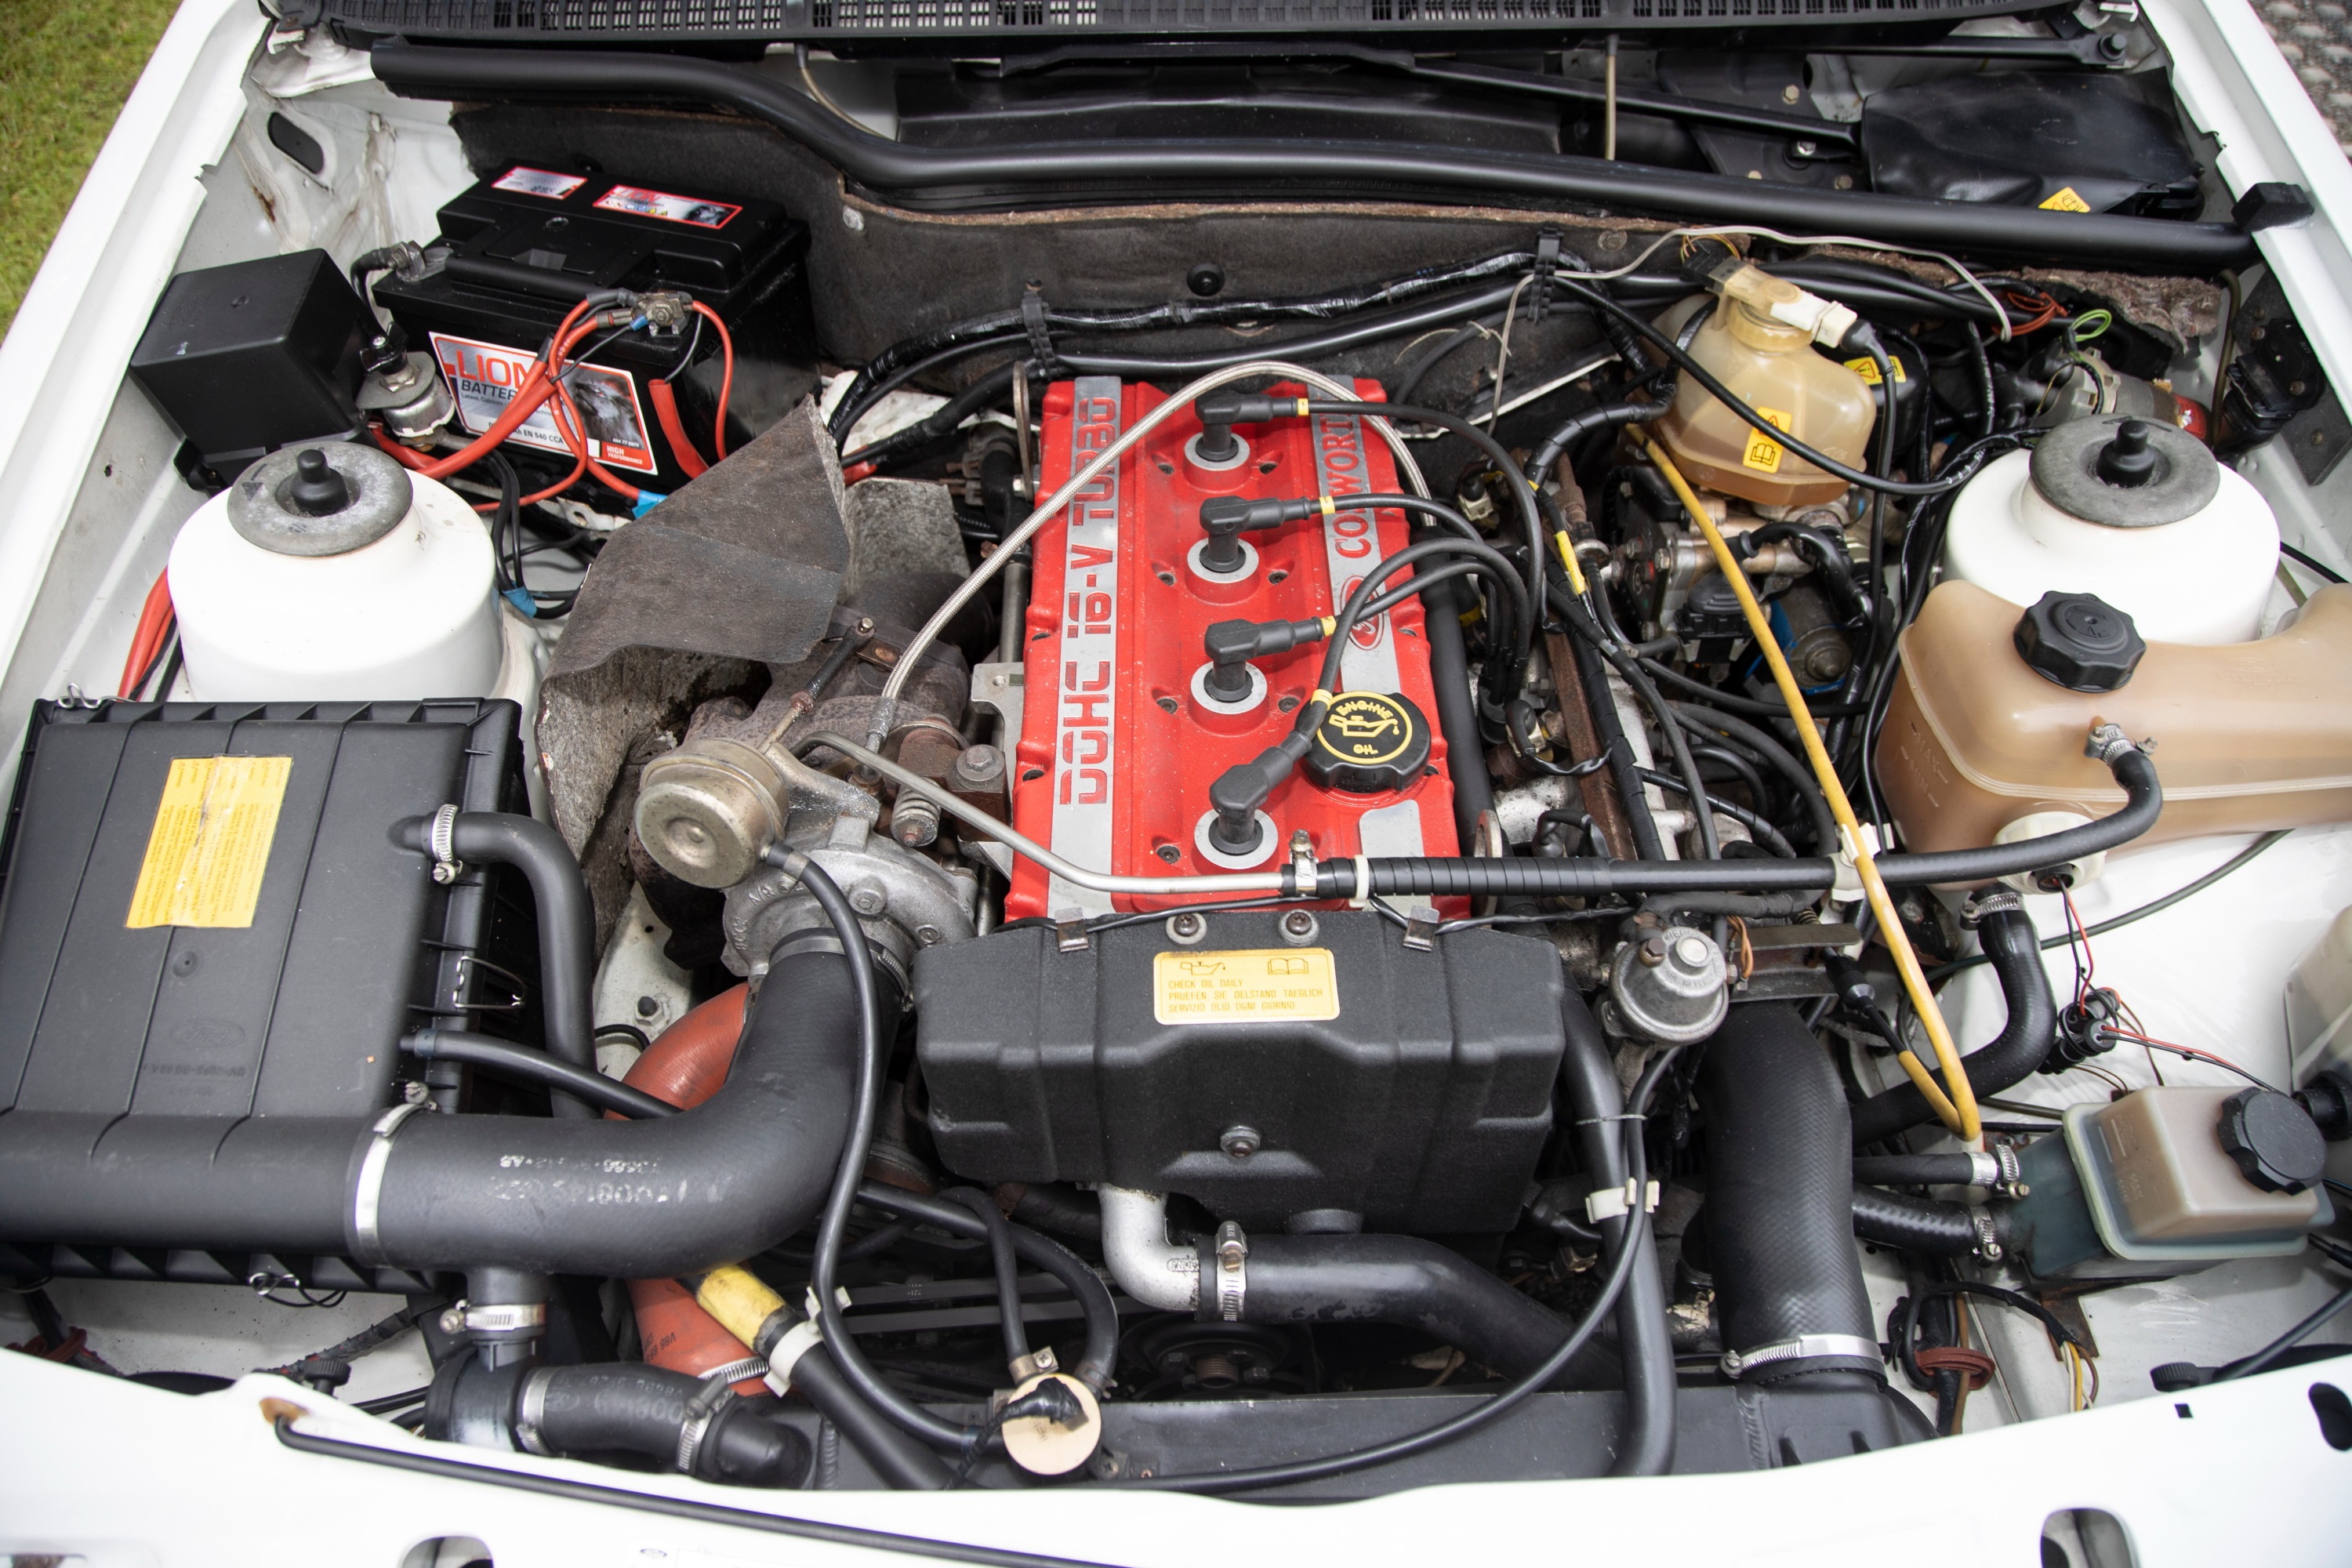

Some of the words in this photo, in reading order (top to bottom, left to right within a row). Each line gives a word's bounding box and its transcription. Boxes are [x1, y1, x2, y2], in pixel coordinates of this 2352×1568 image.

[549, 433, 564, 445] CCA
[606, 445, 625, 456] HIGH
[608, 452, 643, 465] PERFORMANCE
[1318, 397, 1372, 558] COWORT
[1336, 700, 1393, 720] ENGINE
[1059, 661, 1110, 804] DOHC
[1352, 743, 1379, 755] OIL
[1169, 980, 1196, 989] CHECK
[1201, 979, 1214, 989] OIL
[1220, 978, 1243, 988] DAILY
[1169, 992, 1207, 1001] PRUEFEN
[1214, 991, 1227, 1000] SIE
[1234, 990, 1276, 999] OELSTAND
[1283, 989, 1323, 998] TAEGLICH
[1169, 1004, 1206, 1013] SERVIZIO
[1211, 1003, 1230, 1011] OLIO
[1236, 1002, 1256, 1011] OGNI
